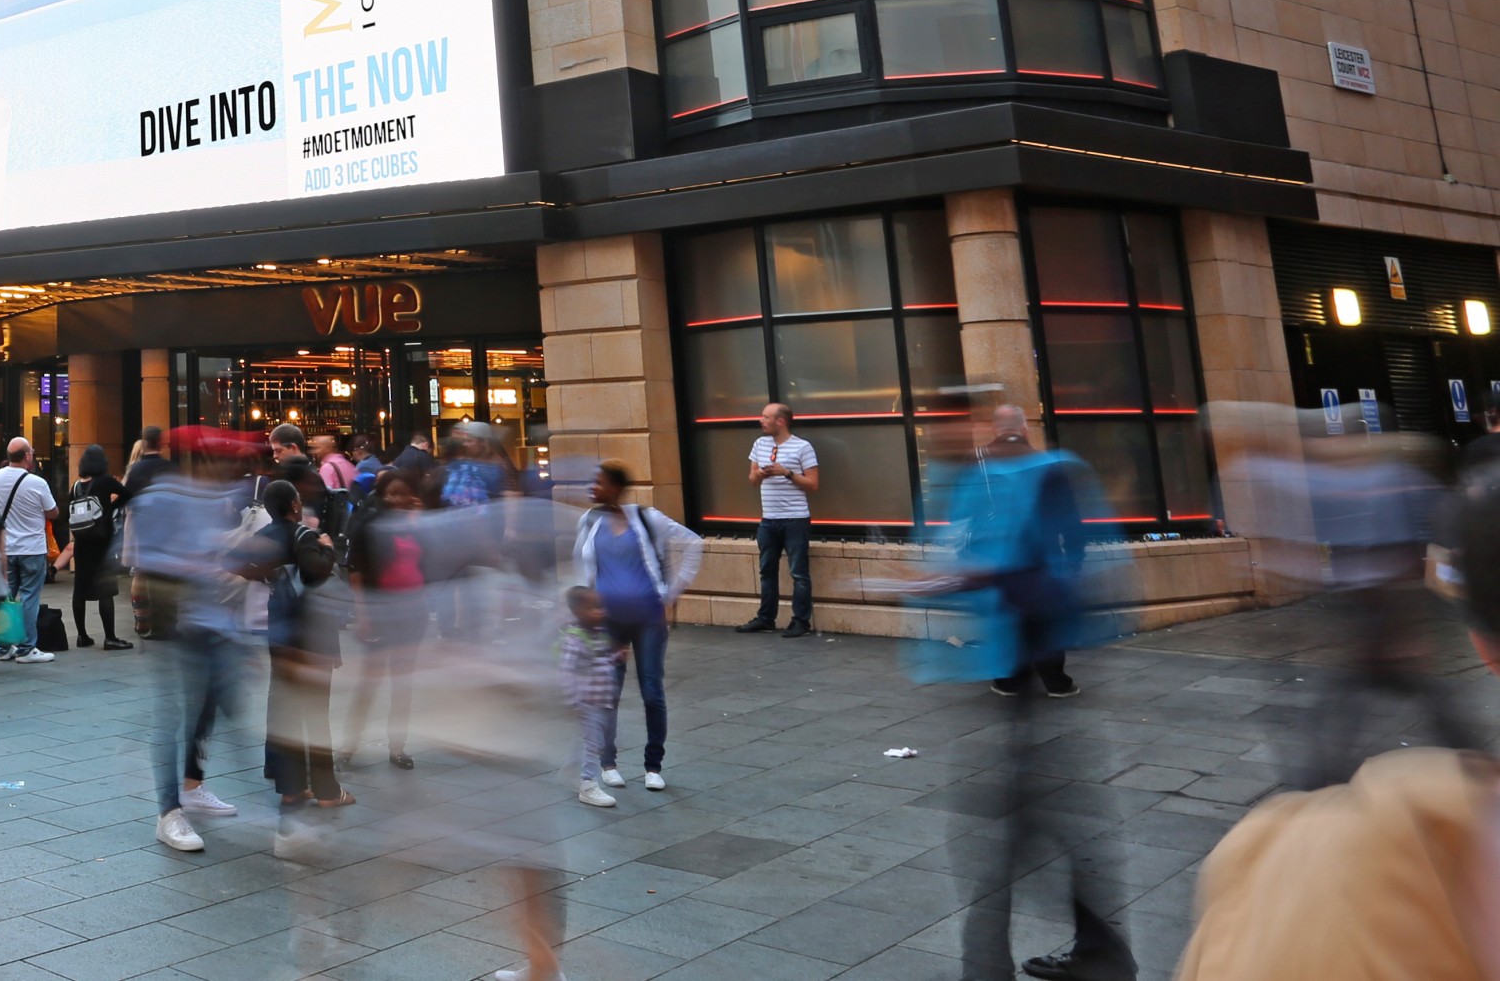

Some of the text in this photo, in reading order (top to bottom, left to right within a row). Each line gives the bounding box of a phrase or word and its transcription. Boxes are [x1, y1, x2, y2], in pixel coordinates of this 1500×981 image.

[1334, 47, 1365, 64] LEICESTER
[1337, 61, 1356, 76] COURT
[292, 36, 449, 123] THE NOW
[139, 80, 277, 157] DIVE INTO
[302, 115, 416, 159] #MOETMOMENT
[304, 150, 418, 193] ADD 3 ICE CUBES
[331, 379, 351, 397] Ba
